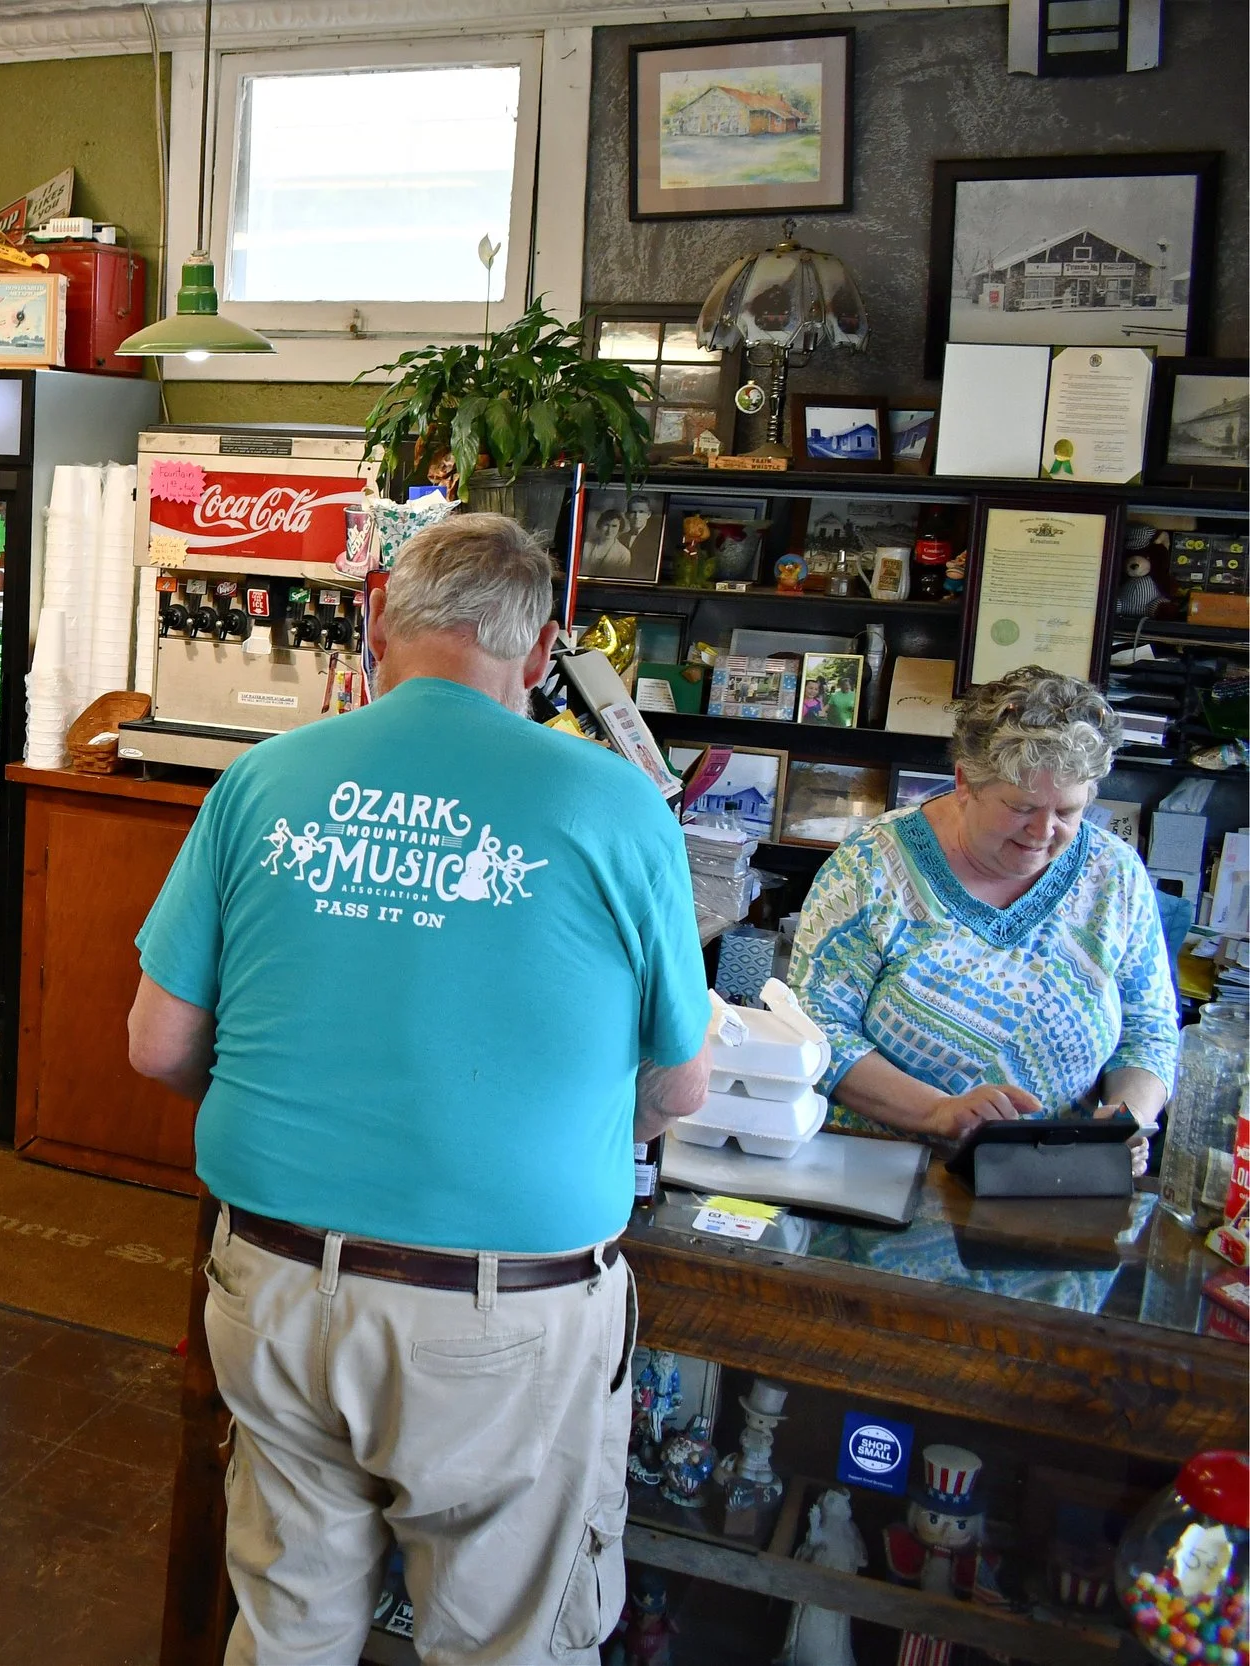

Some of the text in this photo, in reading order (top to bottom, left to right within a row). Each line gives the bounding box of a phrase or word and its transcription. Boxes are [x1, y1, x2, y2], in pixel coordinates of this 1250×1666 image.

[42, 180, 55, 198] IT
[32, 184, 65, 215] LIKES
[38, 198, 61, 219] YOU
[159, 466, 195, 478] Fountain
[193, 484, 320, 534] Coca-Cola
[291, 589, 310, 601] Sprite
[252, 601, 264, 609] ICE
[328, 781, 472, 837] OZARK
[346, 824, 441, 848] MOUNTAIN
[309, 836, 464, 902] MUSIC
[341, 884, 429, 902] ASSOCIATION
[314, 898, 446, 929] PASS IT ON
[857, 1446, 892, 1461] SMALL
[861, 1438, 891, 1452] SHOP
